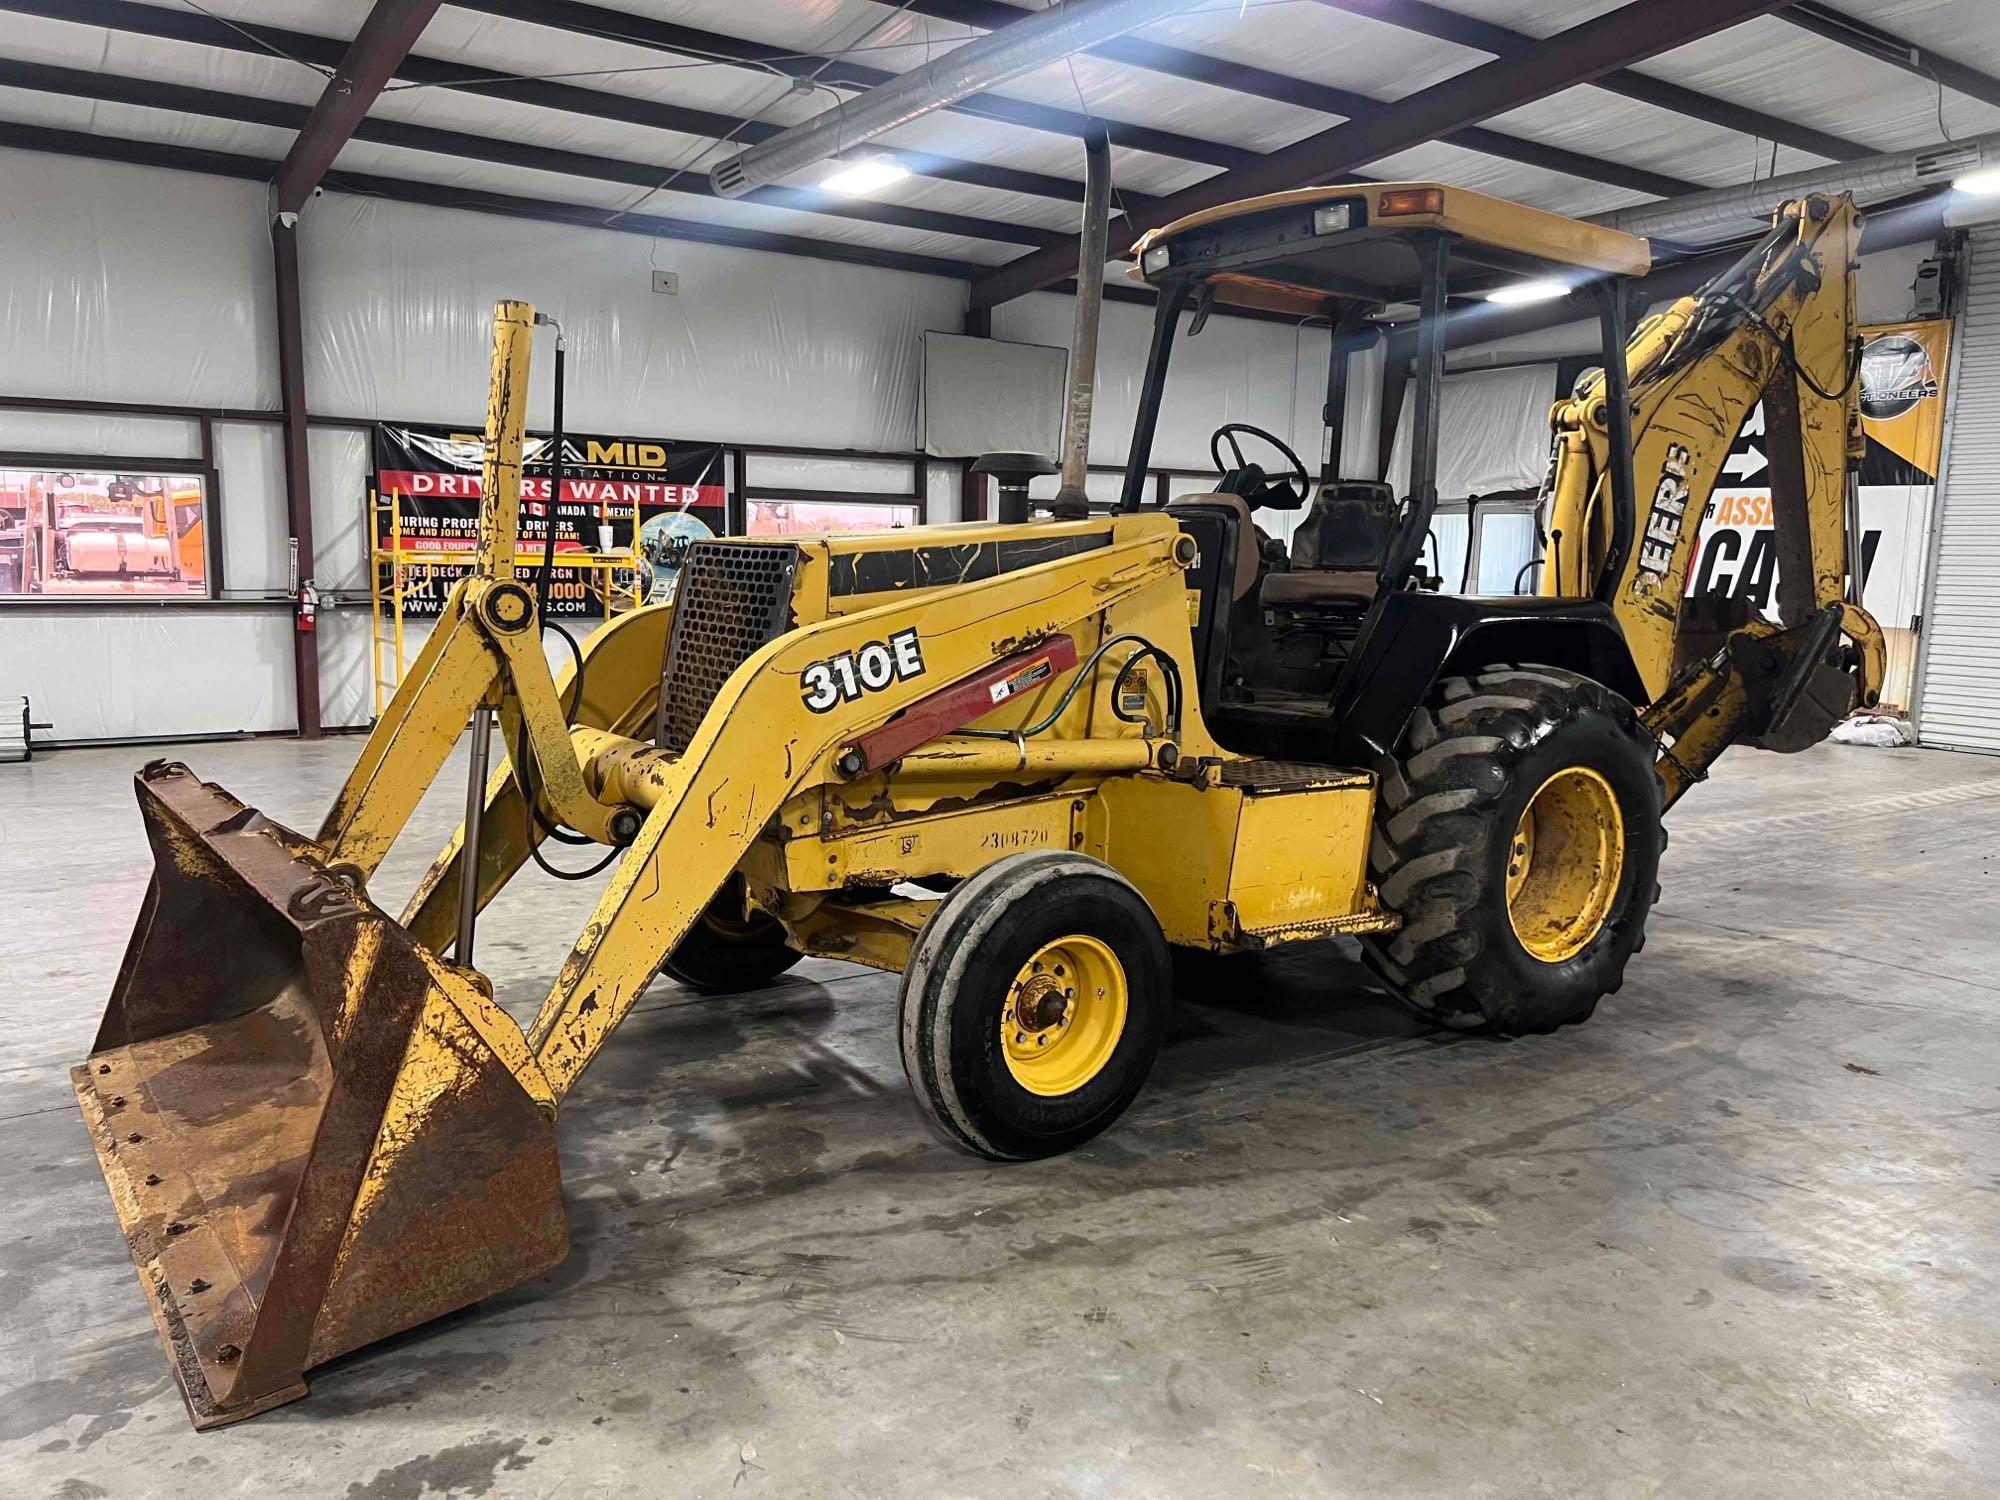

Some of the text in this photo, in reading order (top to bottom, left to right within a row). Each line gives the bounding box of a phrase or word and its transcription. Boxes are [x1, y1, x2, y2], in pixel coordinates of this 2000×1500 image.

[413, 474, 699, 503] DRIRS WANTED
[607, 507, 640, 518] MEXIC
[1634, 444, 1689, 599] DEERE
[419, 528, 438, 537] AND
[441, 528, 461, 538] JOIN
[465, 530, 476, 538] US
[523, 531, 534, 539] OF
[536, 531, 547, 540] TH
[402, 581, 437, 599] ALL
[804, 630, 923, 710] 310E
